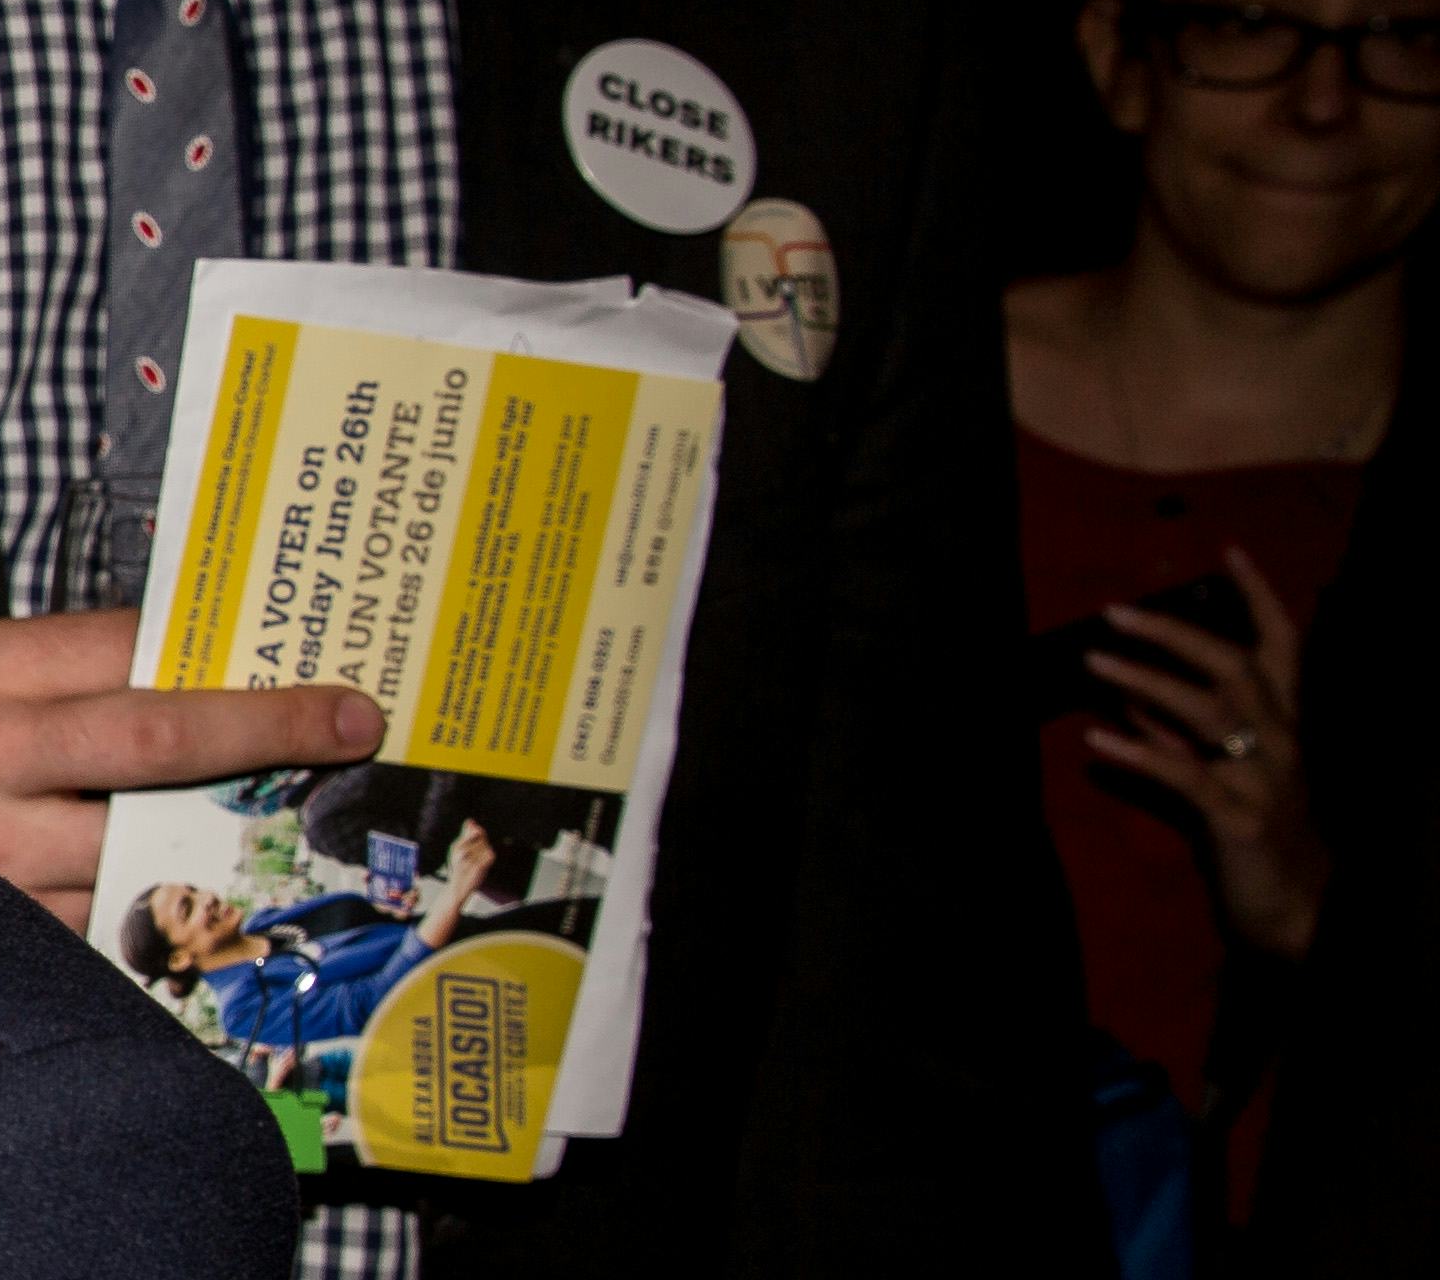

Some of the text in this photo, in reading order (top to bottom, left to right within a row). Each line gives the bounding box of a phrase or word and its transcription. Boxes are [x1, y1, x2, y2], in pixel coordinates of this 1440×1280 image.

[585, 111, 736, 185] RIKERS
[598, 71, 730, 141] CLOSE
[430, 367, 469, 464] junio
[295, 381, 379, 685] esday June 26th
[356, 401, 422, 584] VOTANTE
[412, 468, 446, 514] de
[248, 446, 326, 691] E A VOTER on
[400, 520, 434, 565] 26
[342, 593, 380, 650] UN
[376, 572, 422, 697] martes
